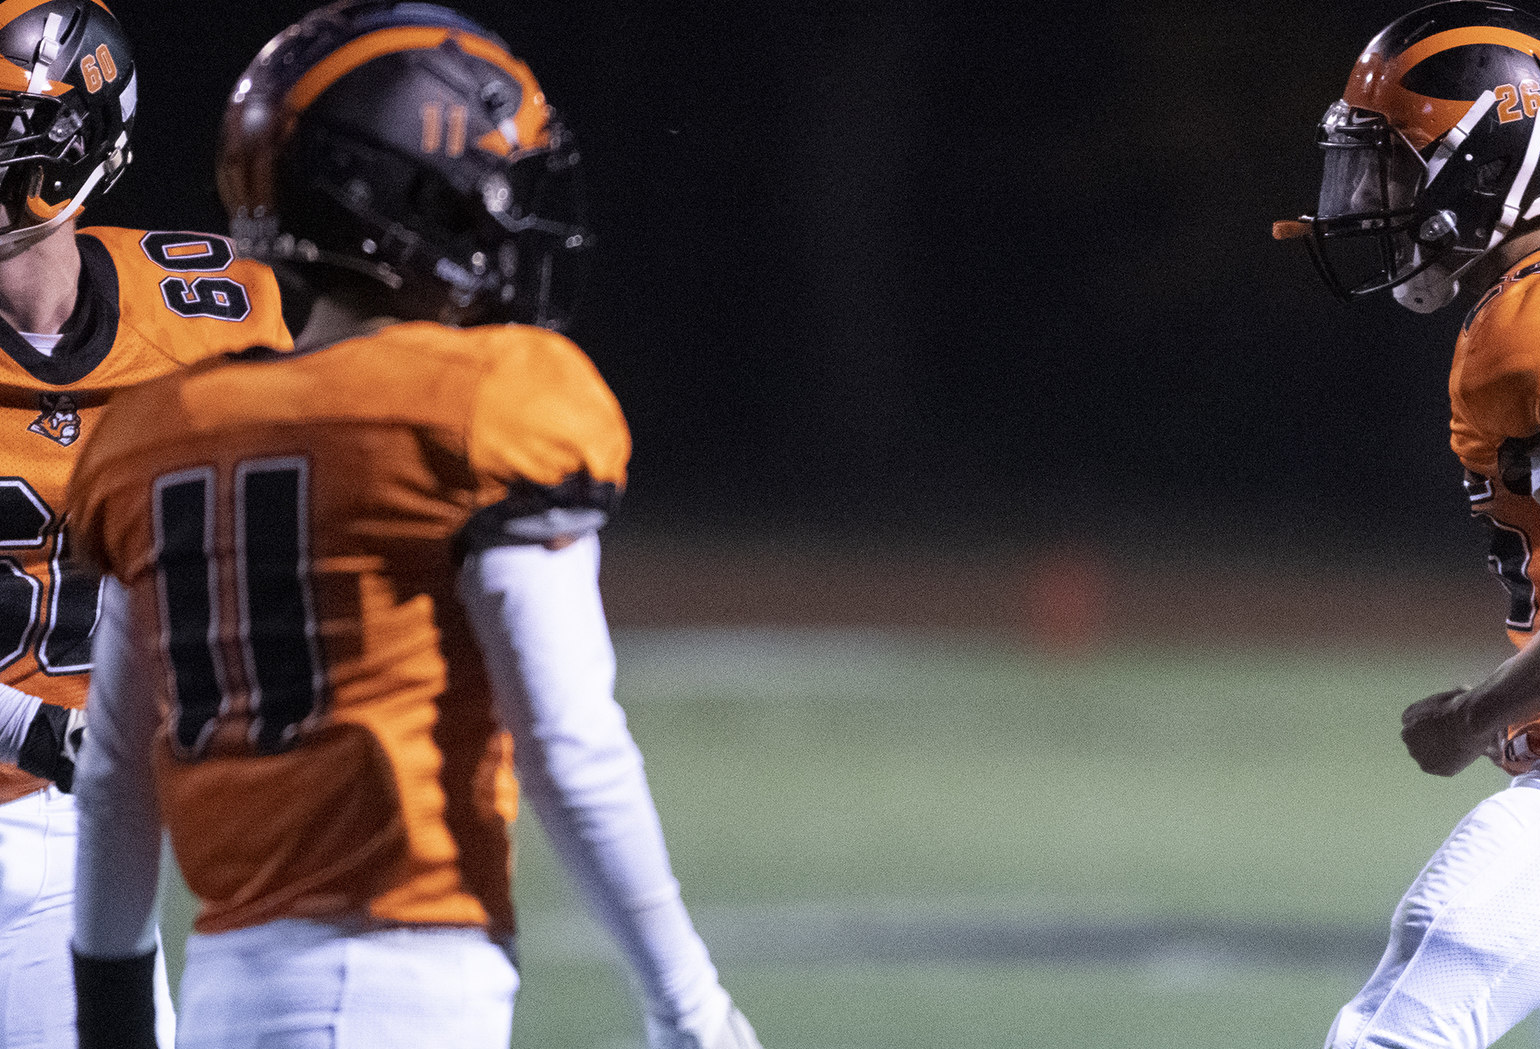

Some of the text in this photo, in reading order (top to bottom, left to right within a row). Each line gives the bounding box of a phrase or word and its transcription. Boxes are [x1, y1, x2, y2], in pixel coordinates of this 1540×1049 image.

[80, 43, 118, 94] 60
[421, 103, 468, 157] 11
[139, 229, 252, 322] 60
[152, 455, 328, 760] 11
